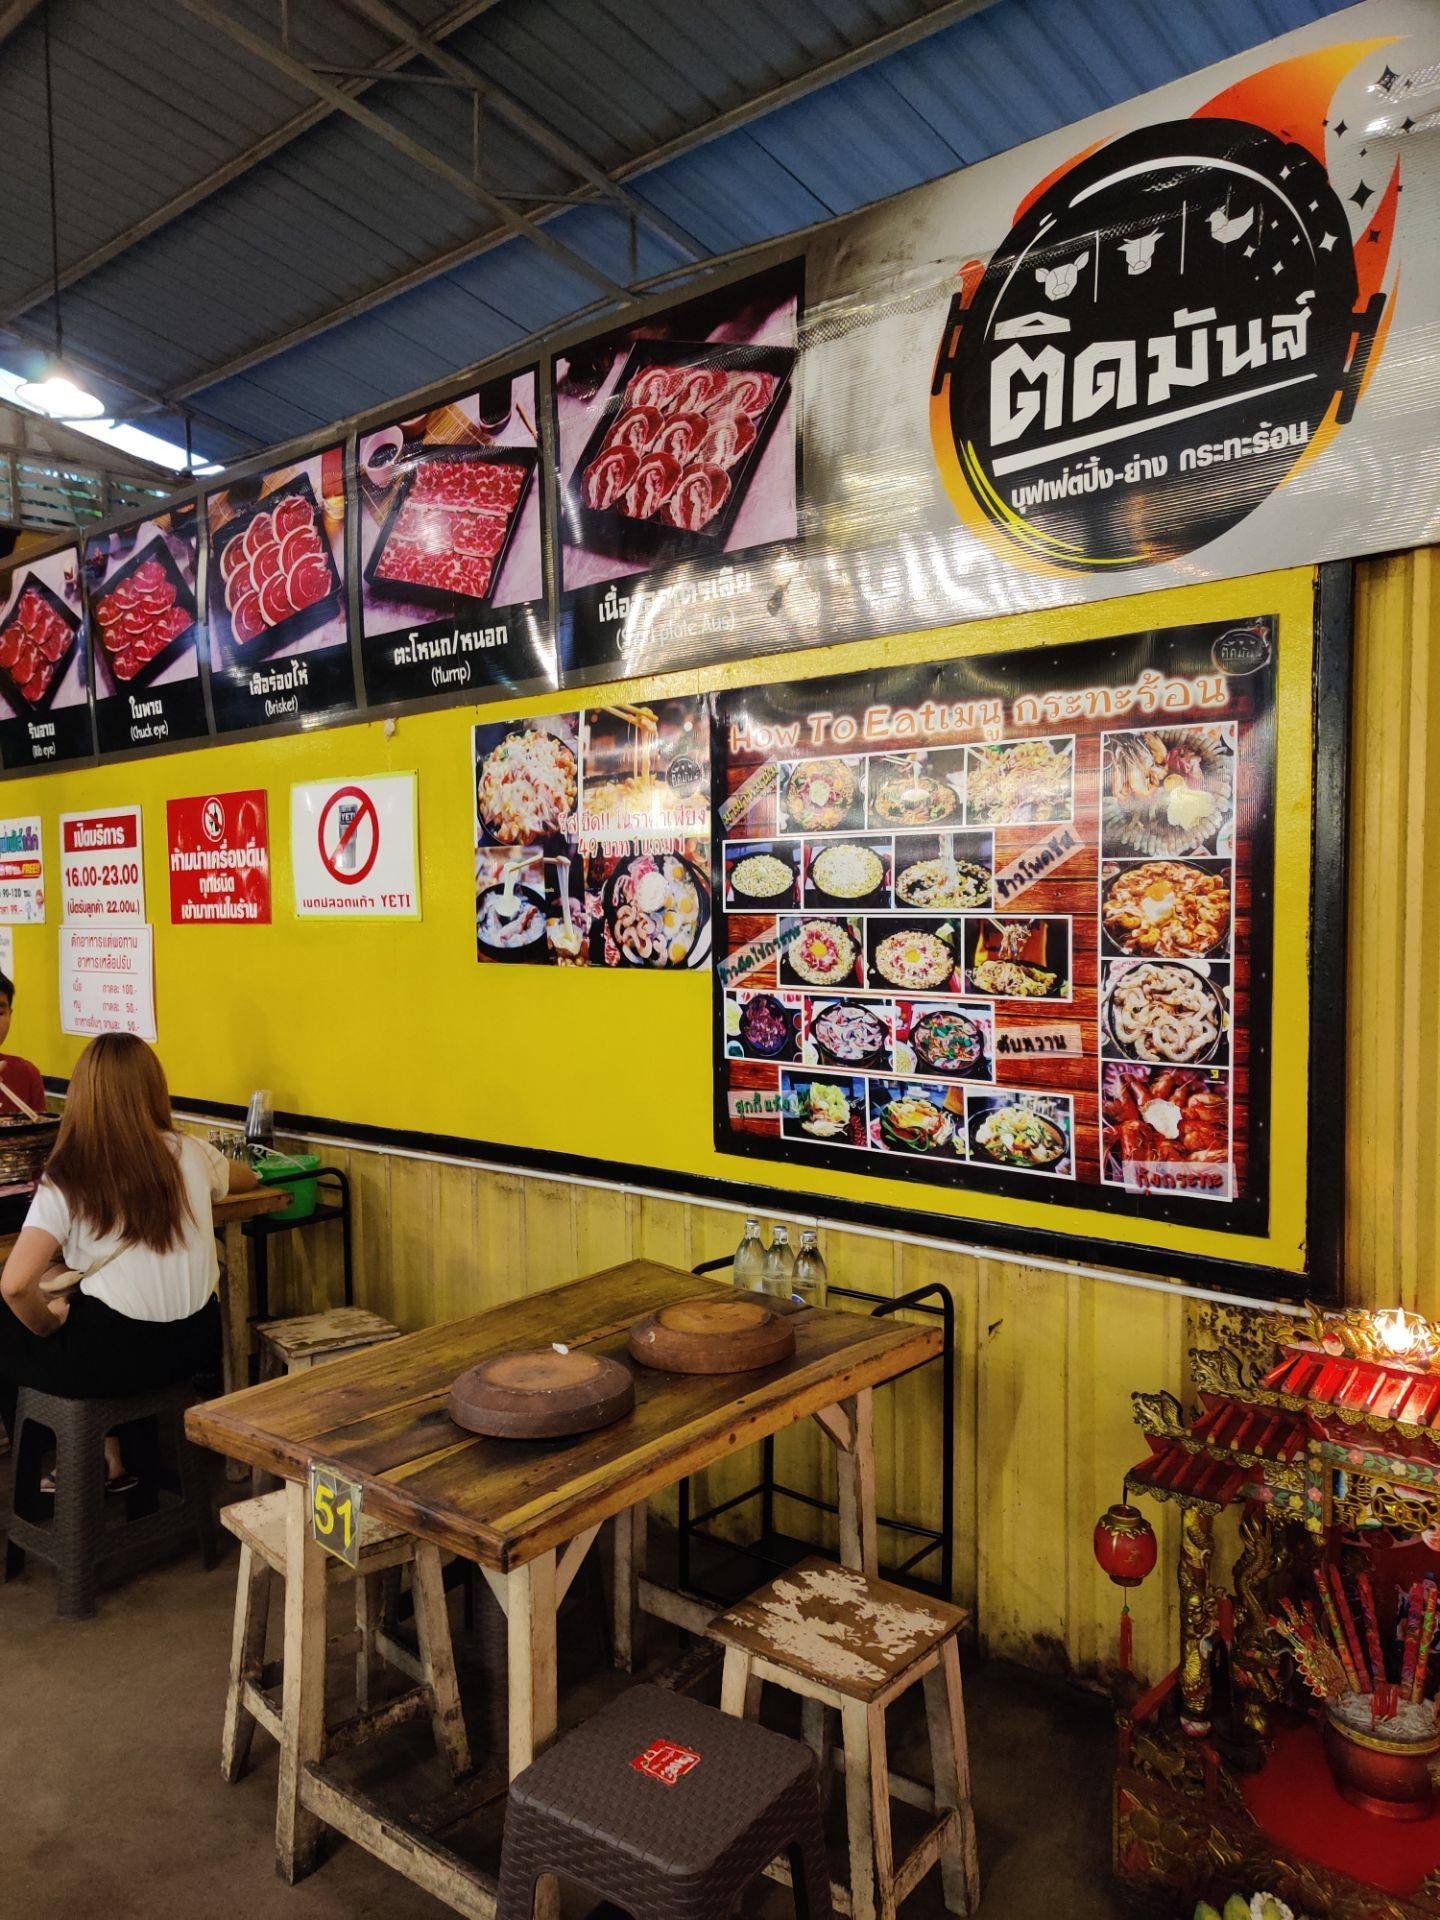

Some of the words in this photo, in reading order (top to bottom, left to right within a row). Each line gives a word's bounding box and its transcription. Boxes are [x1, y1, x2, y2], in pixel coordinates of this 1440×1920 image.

[989, 289, 1316, 447] ติดมันส์
[1179, 421, 1309, 472] กระทะร้อน
[393, 625, 509, 666] ตะโหนก/หนอก
[249, 660, 309, 696] เสือร้องไห้
[128, 695, 163, 719] ใบพาย
[1016, 672, 1226, 722] กระทะร้อน
[73, 822, 125, 848] เปิดบริการ
[170, 836, 266, 872] ห้ามนำเครื่องดื่ม
[65, 863, 138, 887] 16.00-23.00
[199, 872, 236, 899] ทุกชนิด
[181, 895, 258, 920] เข้ามาทานในร้าน
[303, 895, 375, 908] เขตปลอดแก้ว
[380, 894, 411, 908] YETI
[314, 1484, 352, 1548] 51
